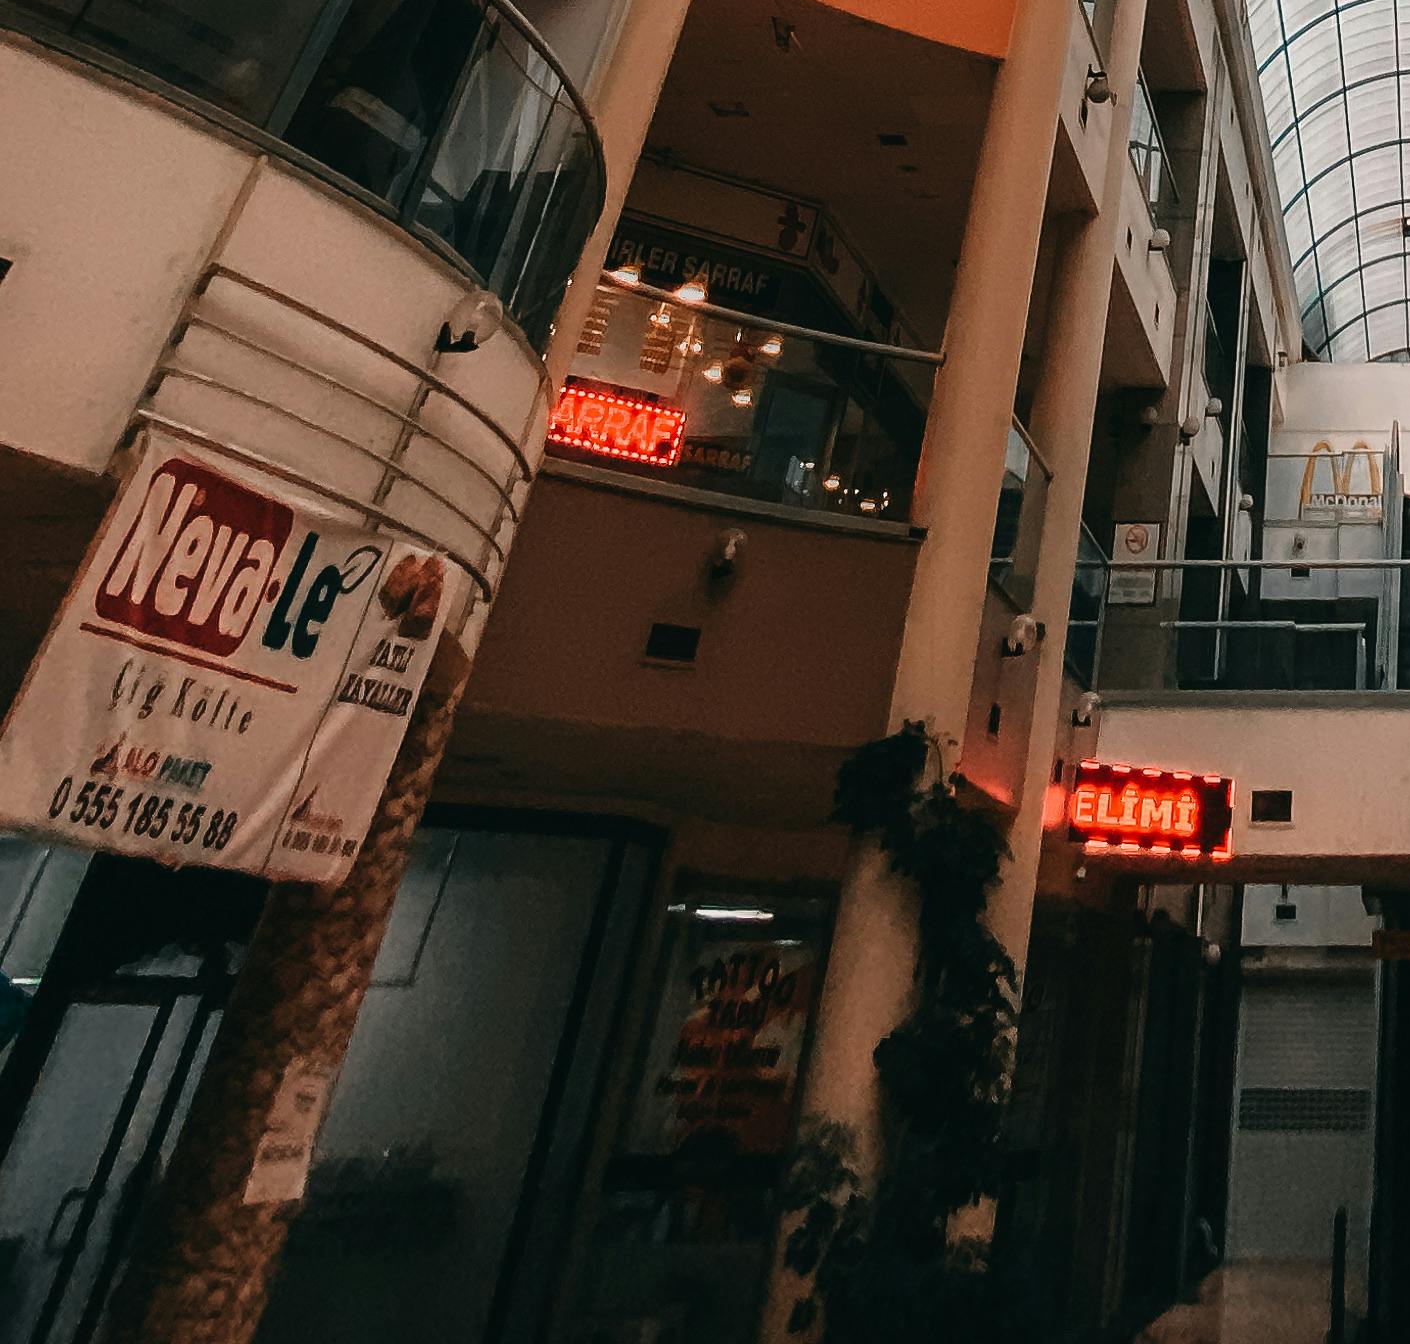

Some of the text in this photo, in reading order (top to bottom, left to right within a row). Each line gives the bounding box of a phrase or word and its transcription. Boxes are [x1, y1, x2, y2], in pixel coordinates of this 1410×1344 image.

[49, 775, 73, 820] 0
[70, 780, 124, 830] 555
[122, 792, 175, 839] 185
[170, 802, 208, 845] 55
[202, 807, 238, 850] 88
